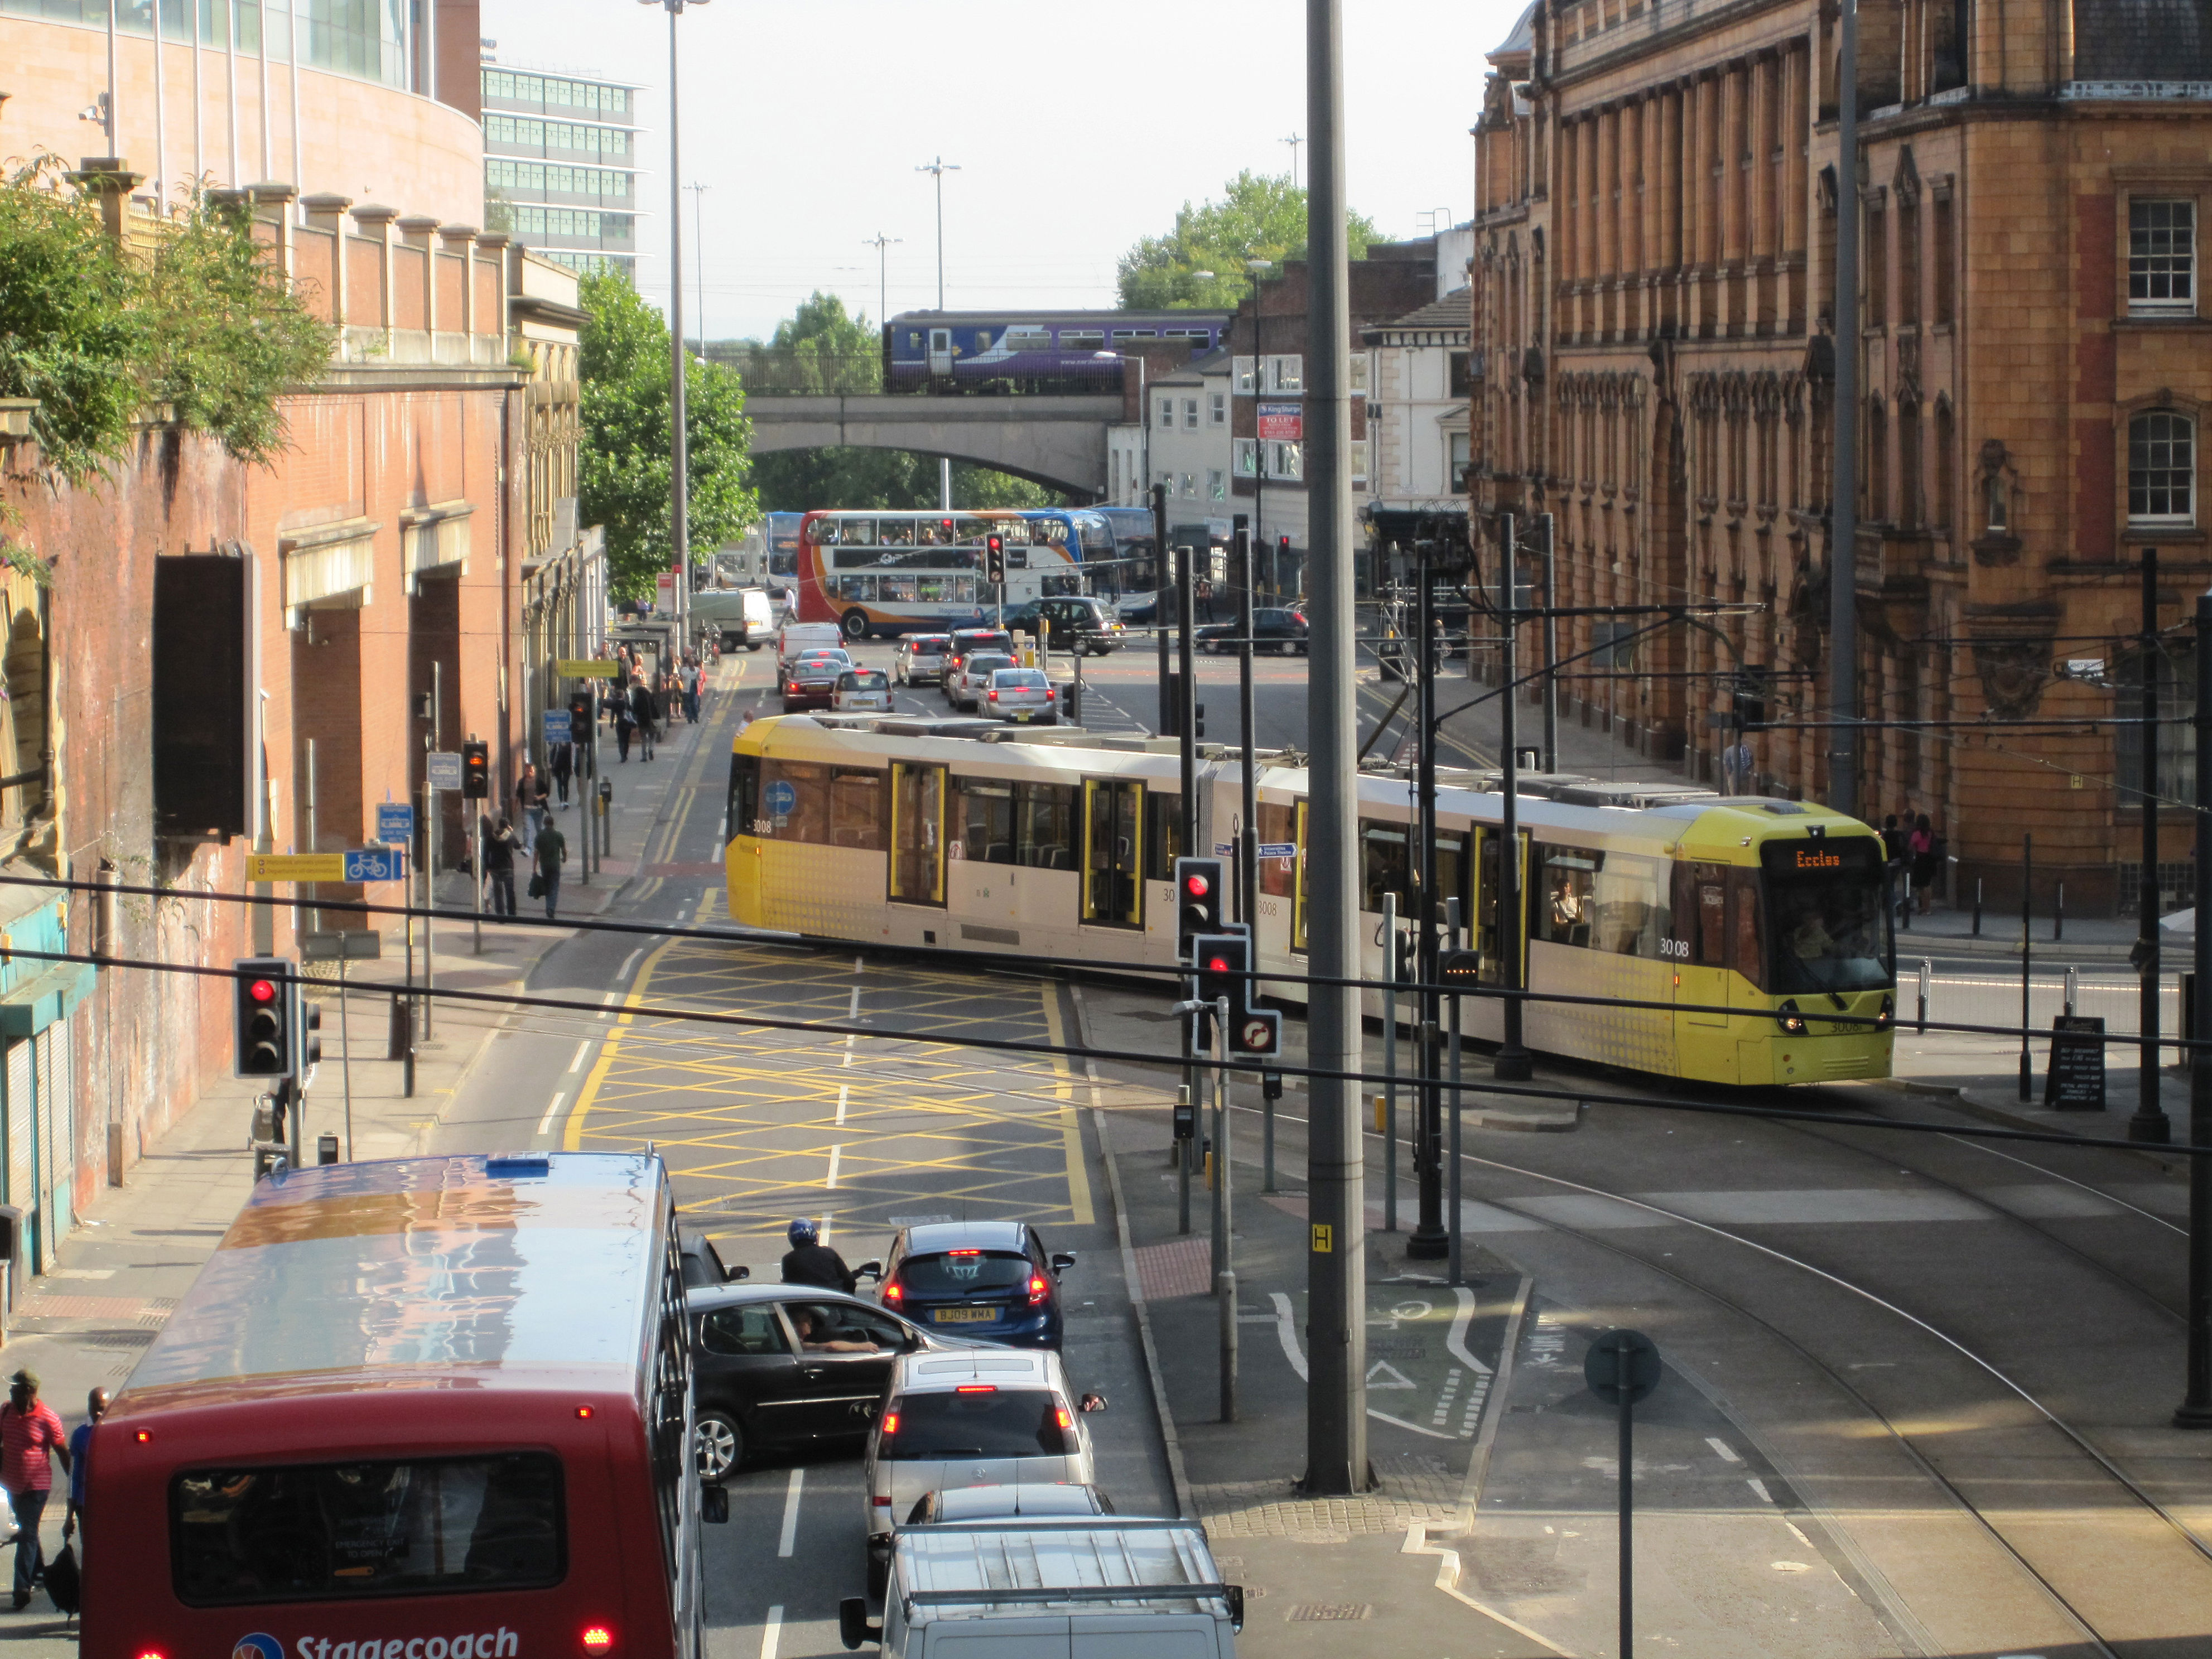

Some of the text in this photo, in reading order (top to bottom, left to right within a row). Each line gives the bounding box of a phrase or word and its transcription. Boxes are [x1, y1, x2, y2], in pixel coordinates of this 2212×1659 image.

[2073, 775, 2081, 787] H
[754, 819, 772, 833] 3008
[1796, 850, 1840, 867] Eccles
[1163, 889, 1175, 902] 30
[1661, 938, 1689, 957] 3008
[1314, 1228, 1328, 1248] H
[940, 1308, 991, 1320] BJ09 WMA
[335, 1537, 404, 1549] EMERGENCY EXIT
[362, 1549, 383, 1557] OPEN
[296, 1627, 519, 1659] Stagecoach
